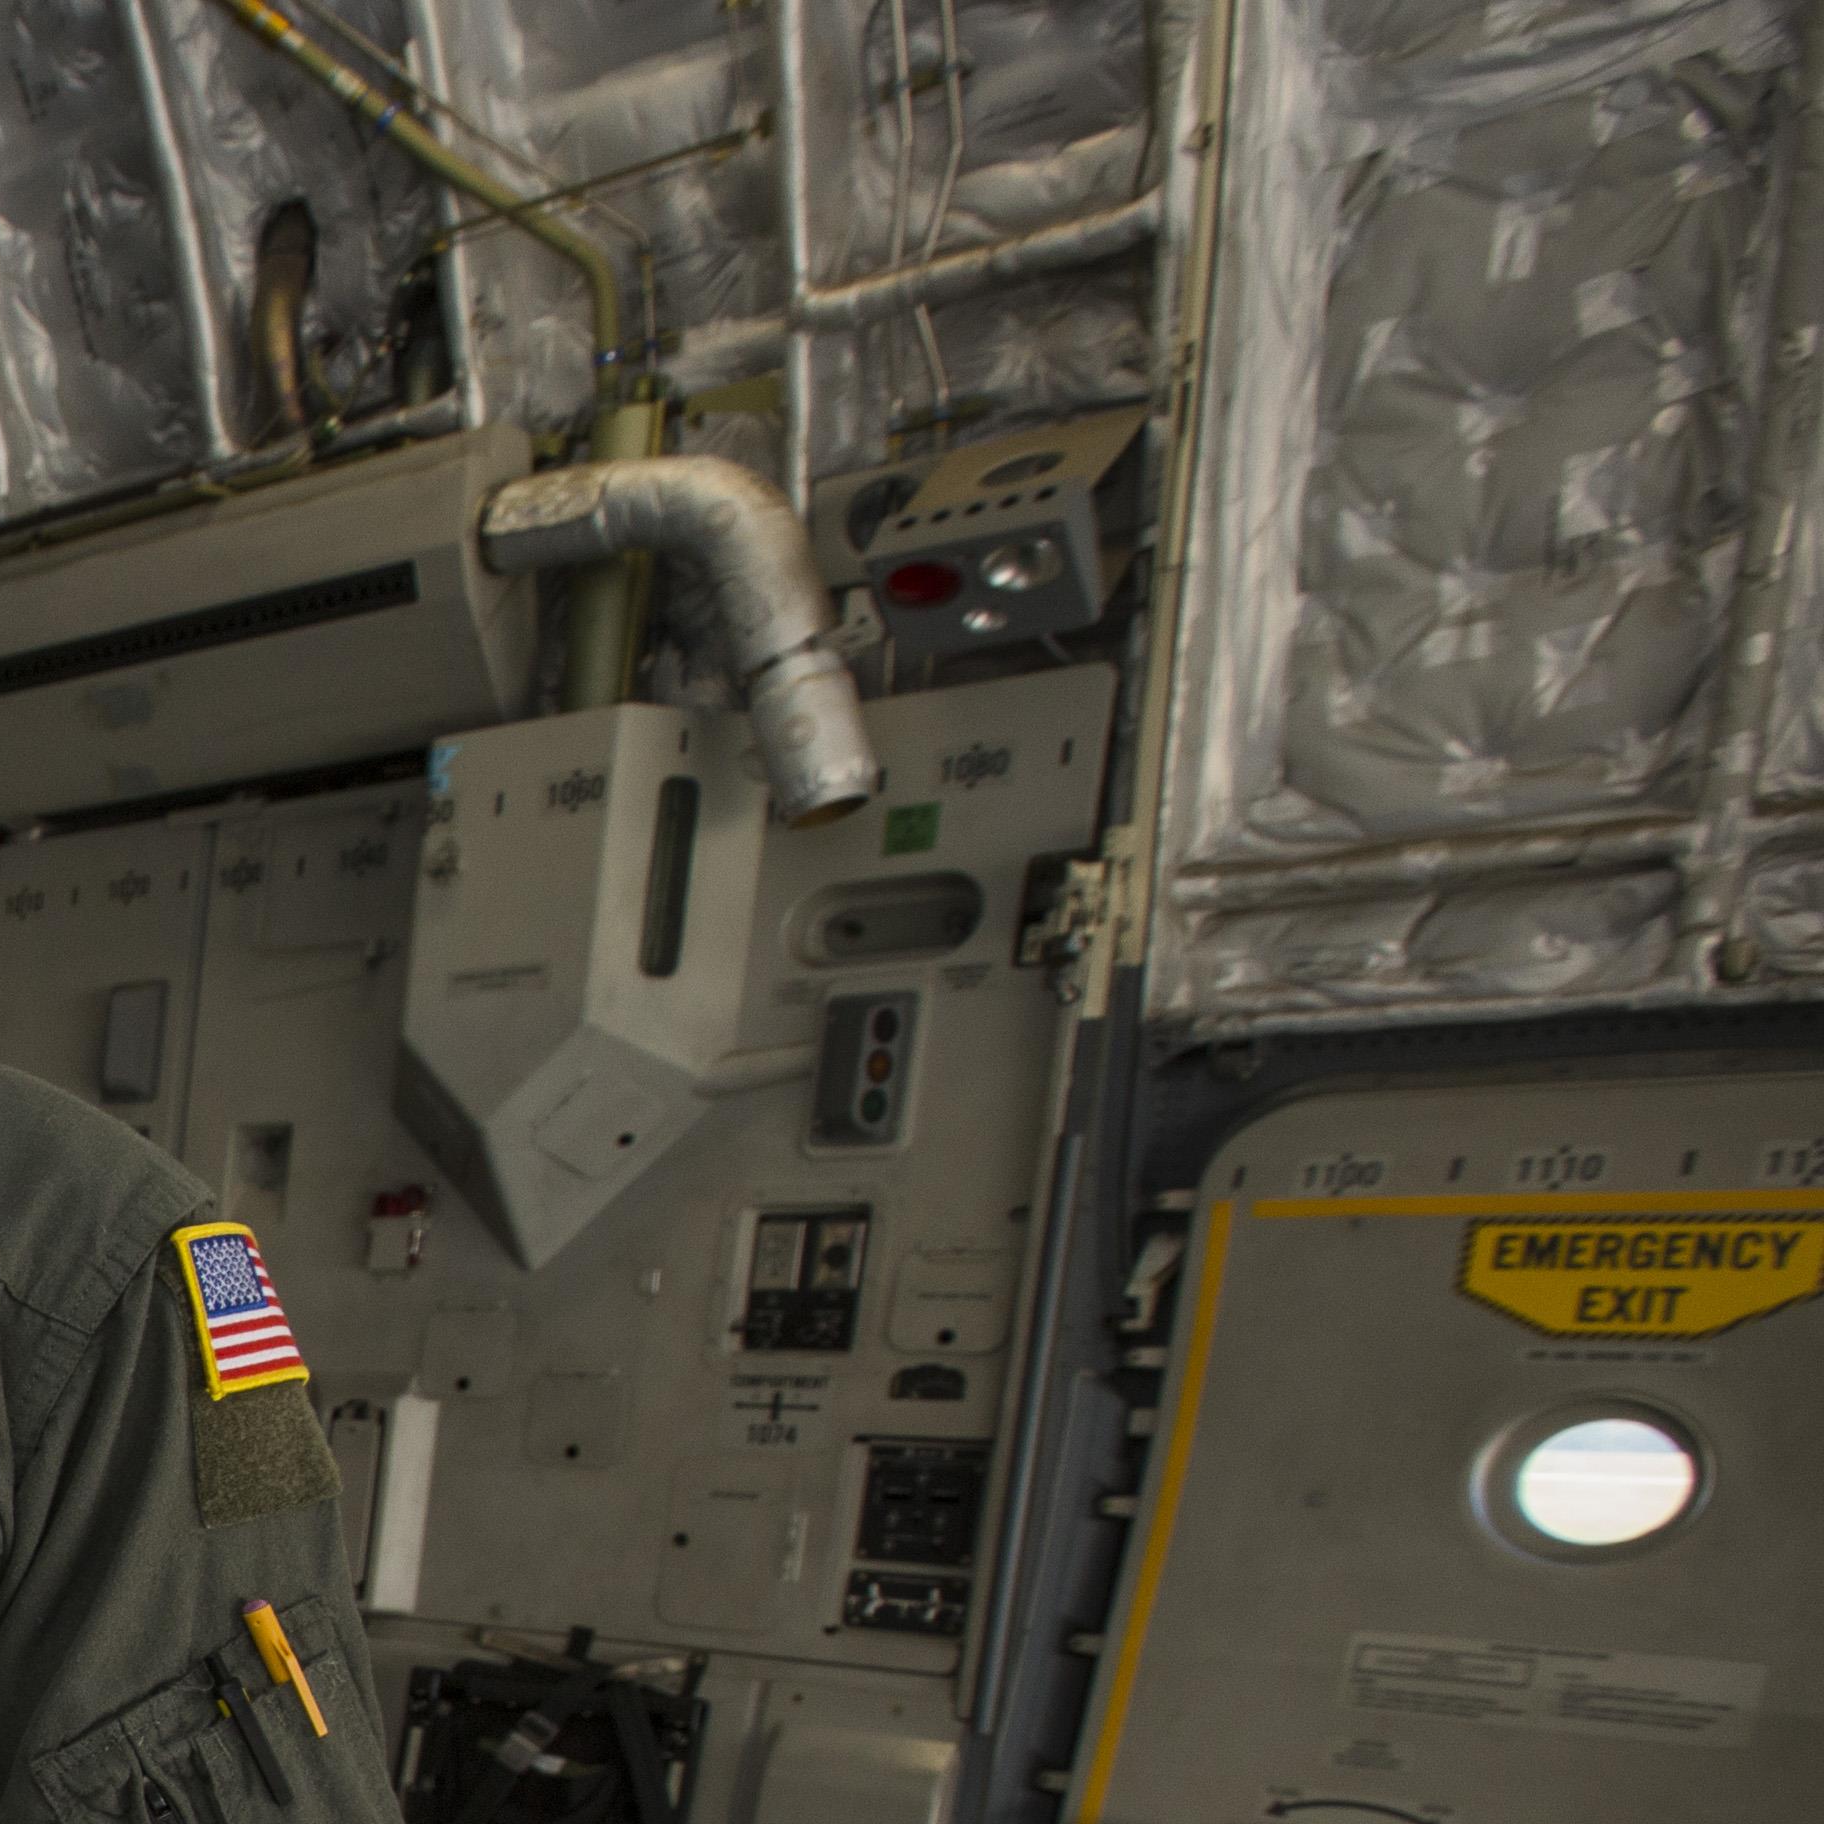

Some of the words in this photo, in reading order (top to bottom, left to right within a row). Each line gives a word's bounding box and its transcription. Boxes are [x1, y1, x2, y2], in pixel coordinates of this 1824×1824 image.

[1516, 1153, 1606, 1182] 1110
[1493, 1233, 1805, 1270] EMERGENCY
[1574, 1286, 1689, 1324] EXIT
